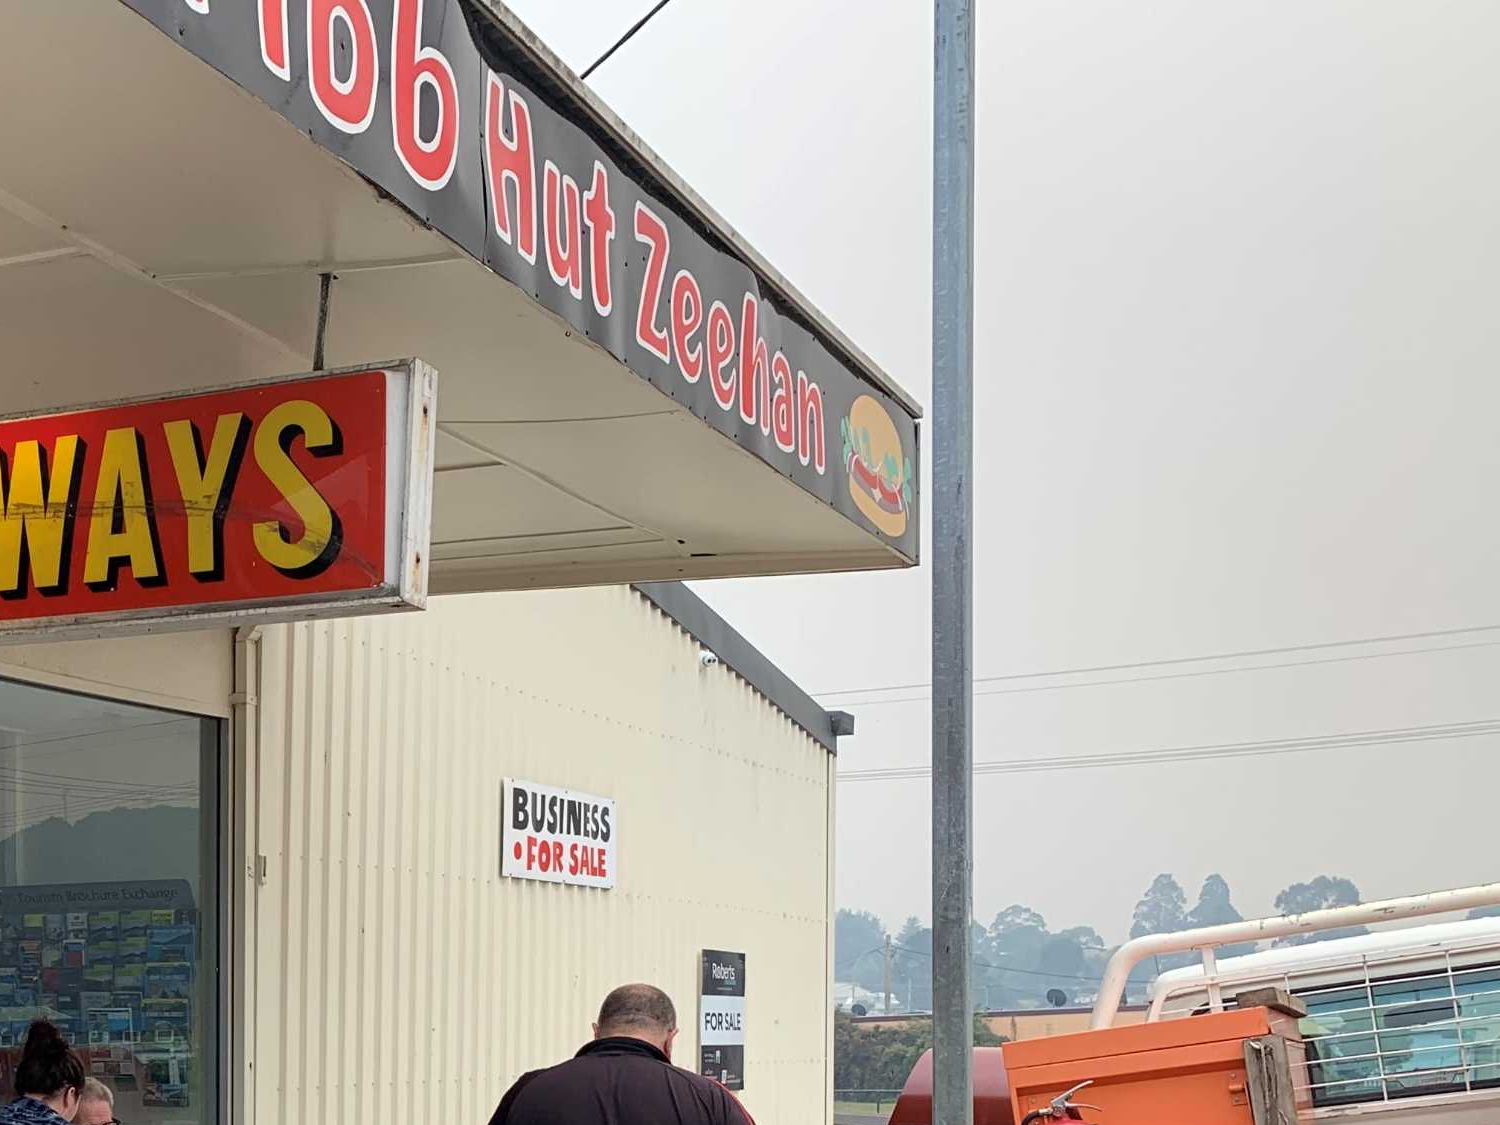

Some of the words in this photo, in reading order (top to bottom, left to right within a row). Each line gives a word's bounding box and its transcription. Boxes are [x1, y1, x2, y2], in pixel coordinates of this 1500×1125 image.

[485, 69, 616, 317] Hut
[634, 200, 826, 476] Zeehan
[512, 787, 611, 843] BUSINESS
[526, 835, 564, 874] FOR
[569, 841, 607, 878] SALE
[121, 885, 180, 904] Exchange
[712, 962, 735, 980] Roberts
[704, 1012, 723, 1031] FOR
[724, 1012, 741, 1031] SALE
